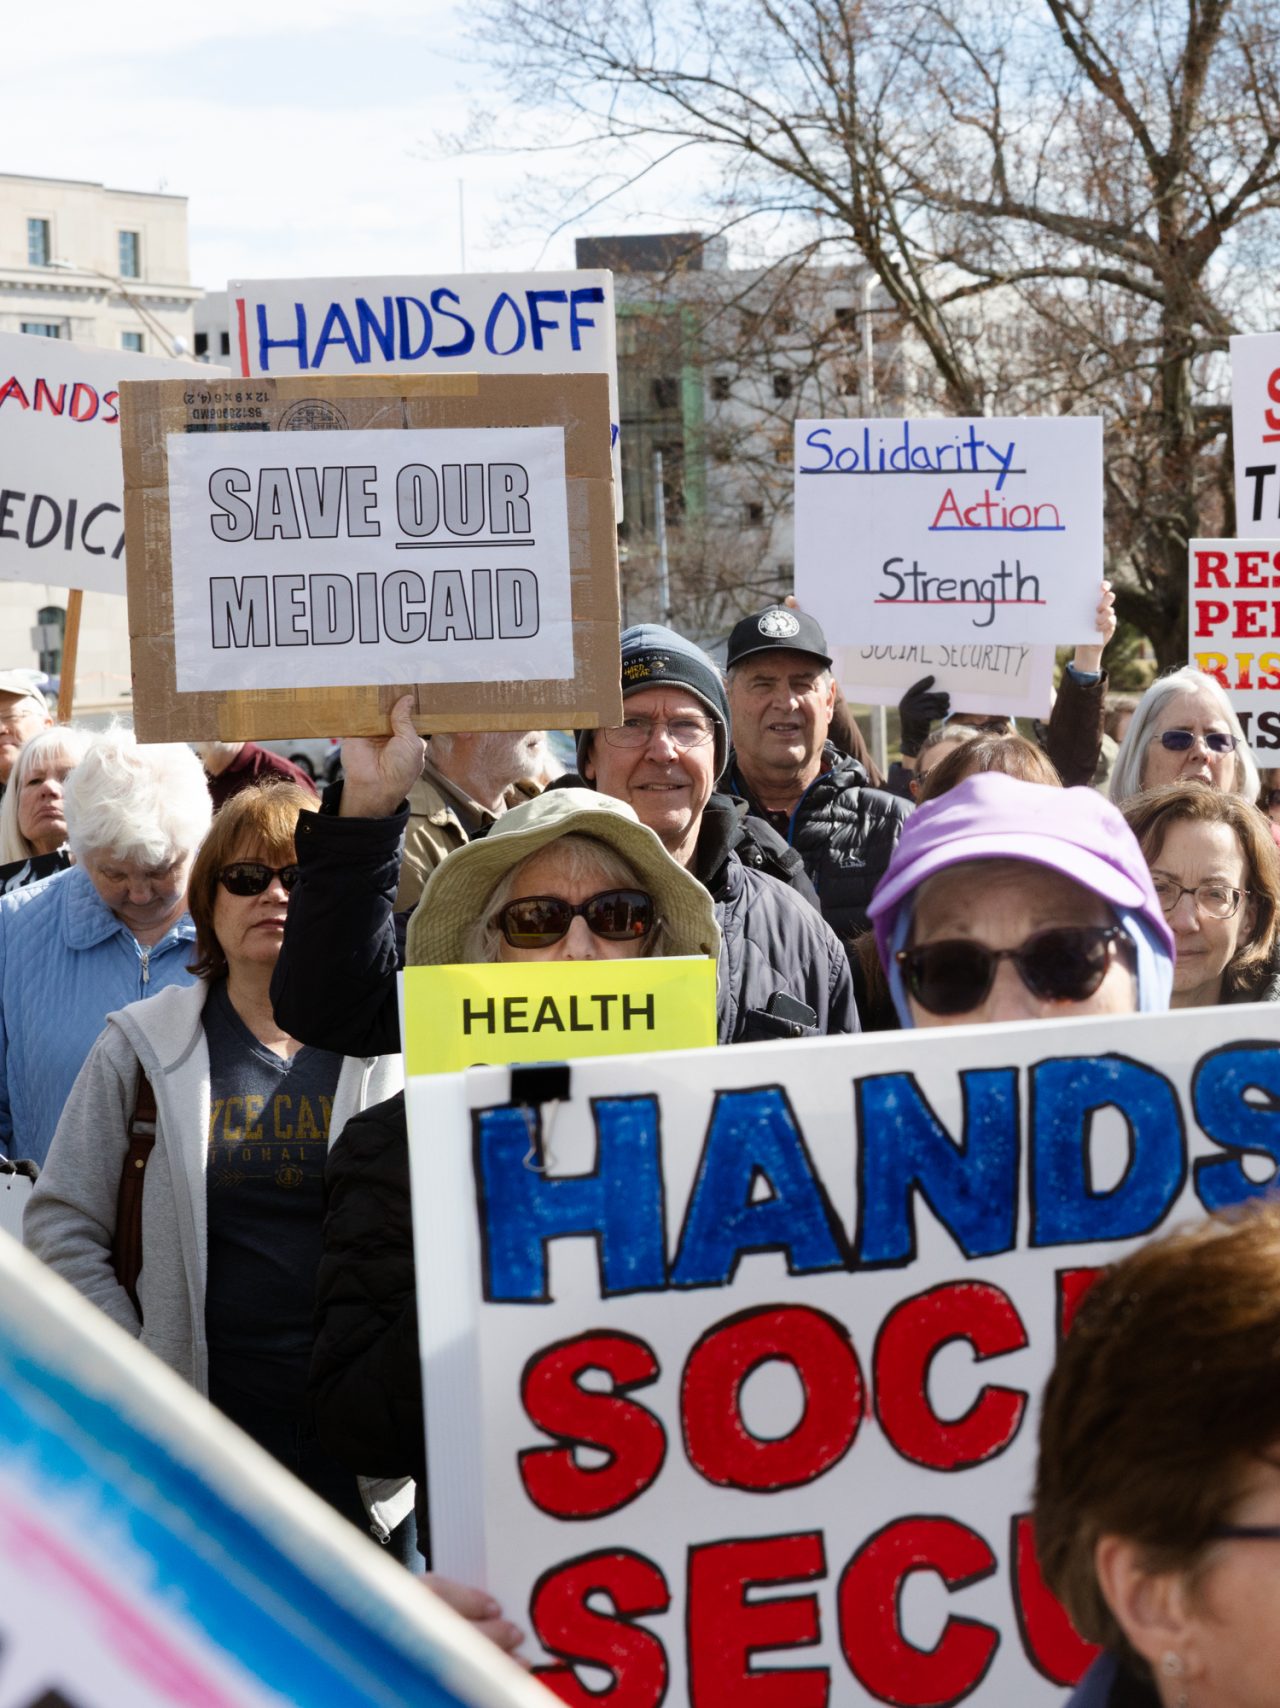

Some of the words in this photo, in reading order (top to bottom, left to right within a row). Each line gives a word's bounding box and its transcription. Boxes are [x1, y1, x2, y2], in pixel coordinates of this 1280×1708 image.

[257, 287, 475, 370] HANDS
[485, 286, 605, 356] OFF
[803, 421, 1015, 491] Solidarity
[0, 489, 125, 560] EDIC
[209, 466, 381, 542] SAVE
[396, 463, 532, 537] OUR
[929, 489, 1060, 528] Action
[209, 568, 540, 649] MEDICAID
[879, 558, 1040, 628] Strength
[462, 994, 655, 1035] HEALTH
